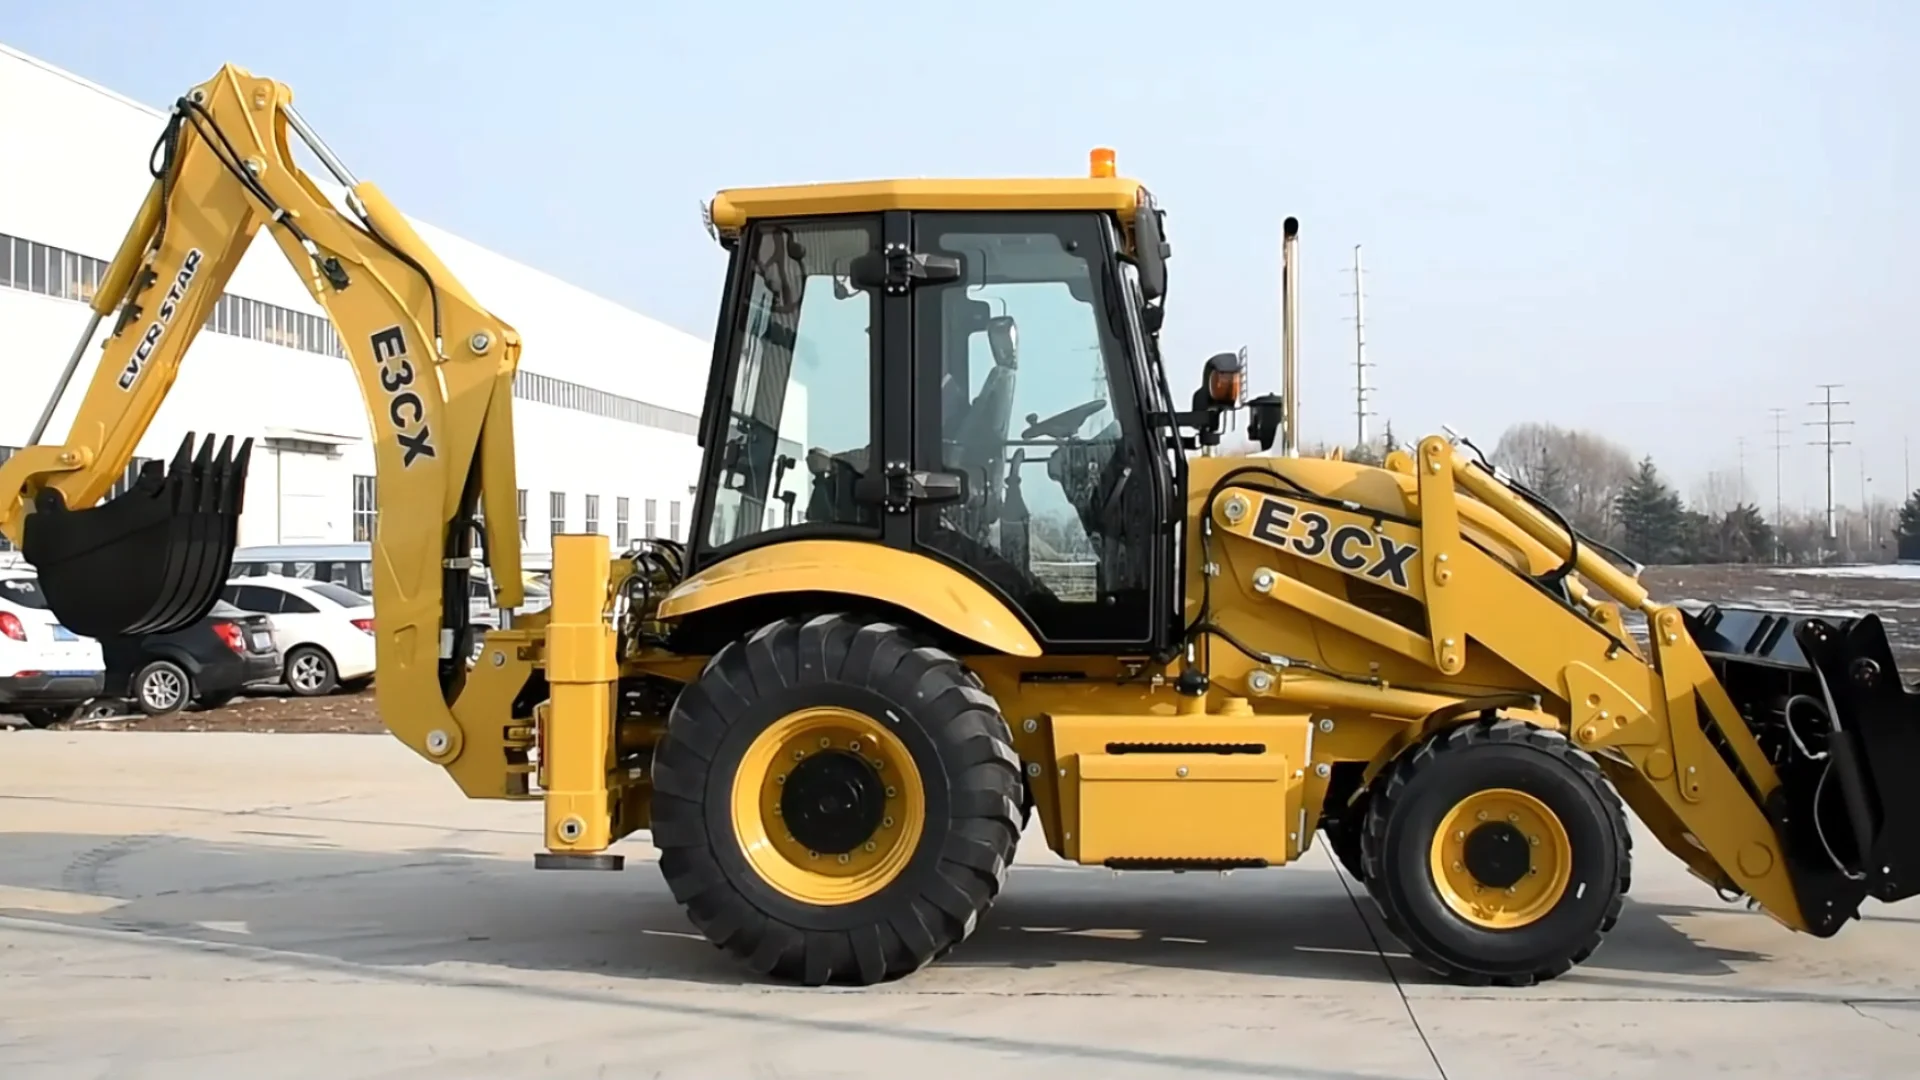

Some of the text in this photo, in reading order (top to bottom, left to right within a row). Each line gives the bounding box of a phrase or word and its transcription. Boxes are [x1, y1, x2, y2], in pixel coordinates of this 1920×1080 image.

[118, 249, 202, 390] EVER STAR
[370, 325, 436, 468] E3CX
[1252, 498, 1418, 588] E3CX
